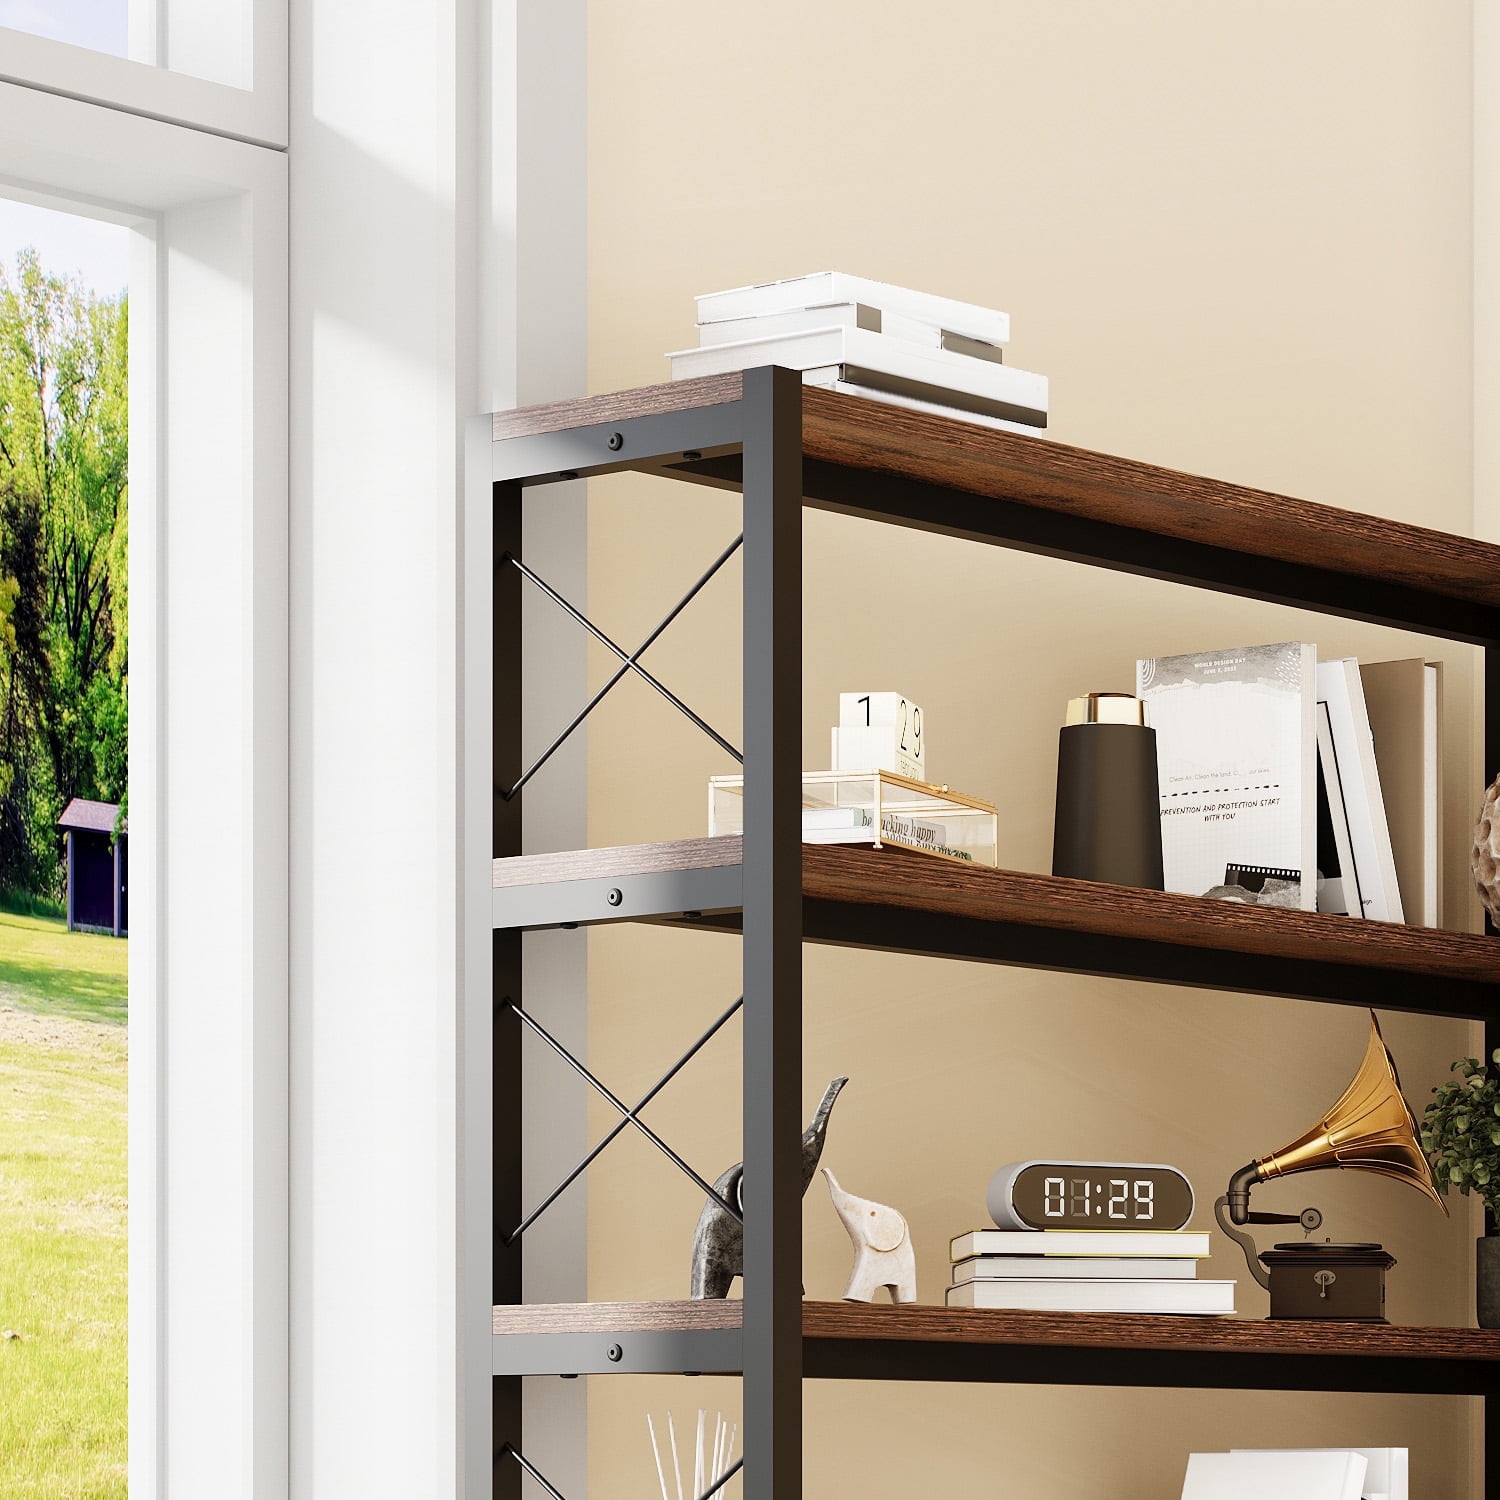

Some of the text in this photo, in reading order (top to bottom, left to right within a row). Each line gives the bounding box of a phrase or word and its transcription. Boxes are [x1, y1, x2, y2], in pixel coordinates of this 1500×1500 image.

[857, 695, 870, 727] 1
[1160, 797, 1281, 817] PREVENTION AND PROTECTION START
[1204, 812, 1236, 822] WITH YOU
[861, 808, 937, 844] be ucking happy
[1044, 1177, 1154, 1220] 01:29
